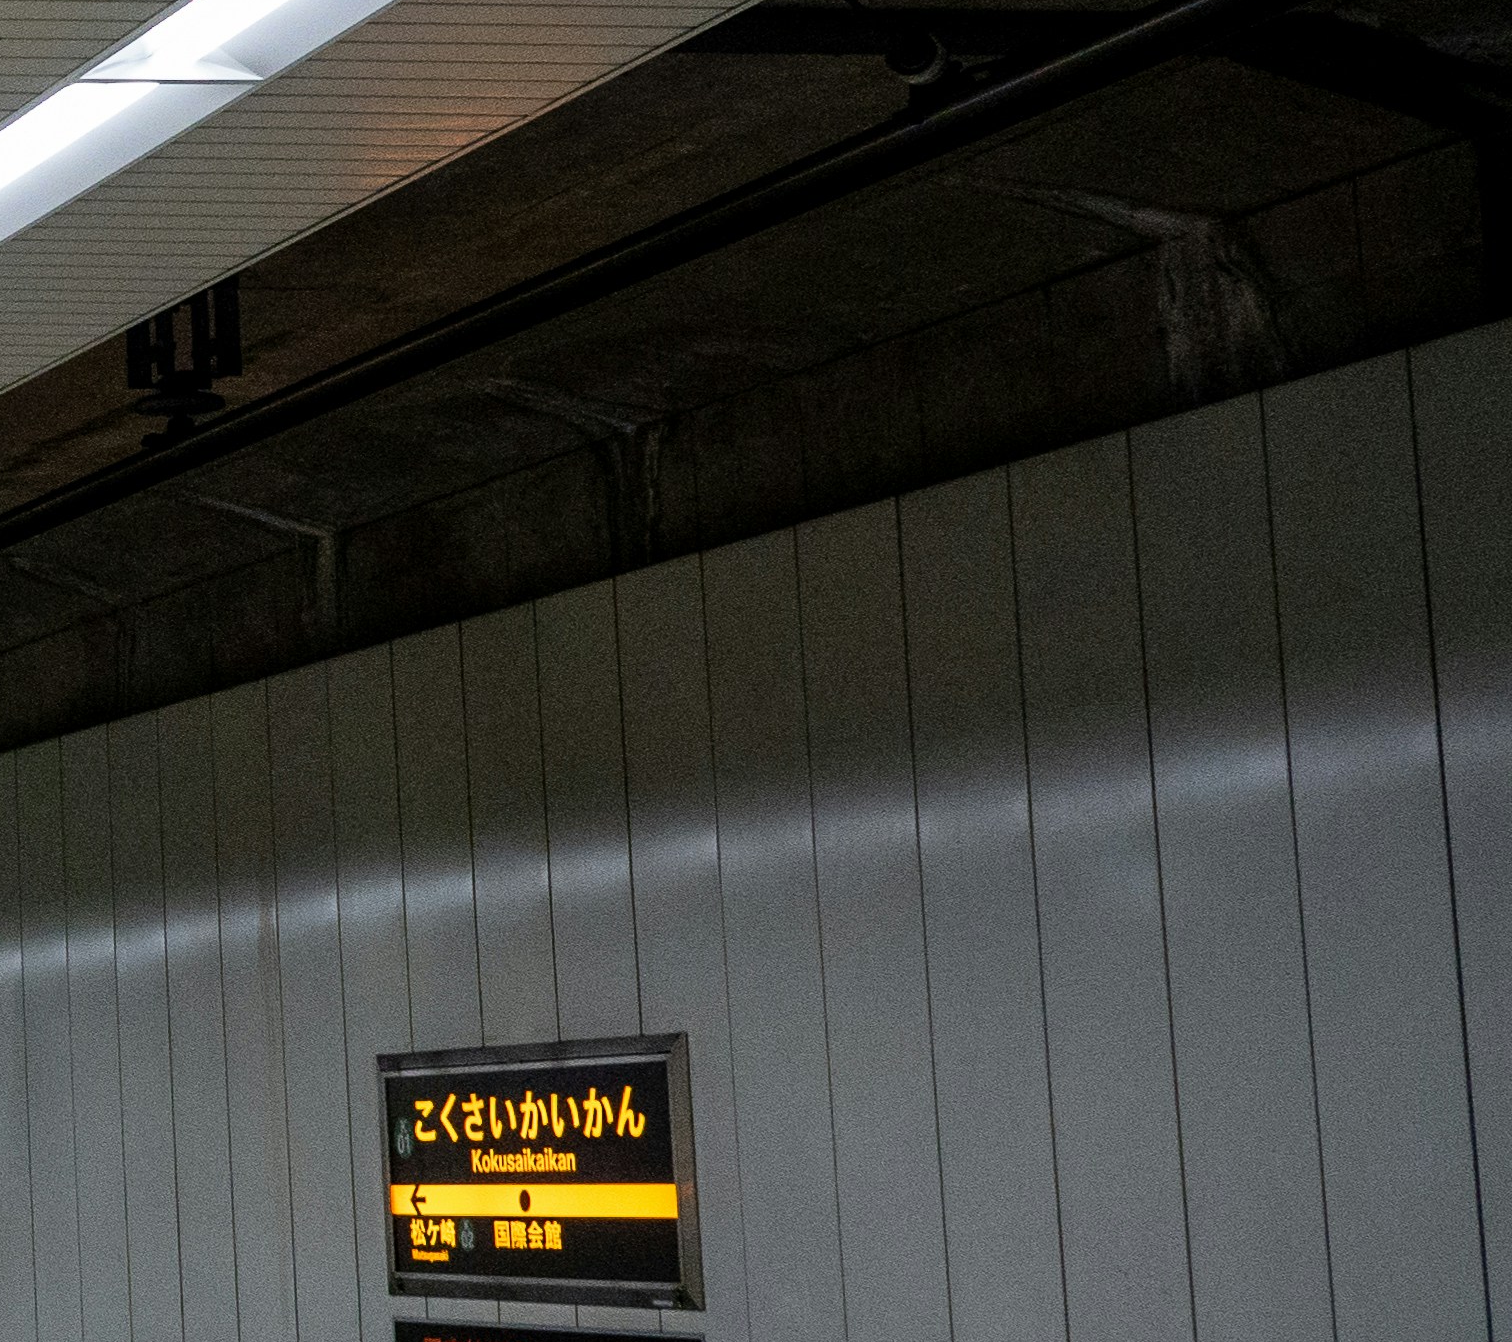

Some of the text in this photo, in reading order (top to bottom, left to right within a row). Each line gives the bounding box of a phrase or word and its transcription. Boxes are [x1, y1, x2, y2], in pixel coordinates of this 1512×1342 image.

[413, 1086, 647, 1142] こくさいかいかん
[470, 1148, 577, 1173] Kokusaikaikan
[493, 1220, 562, 1250] 国際会館
